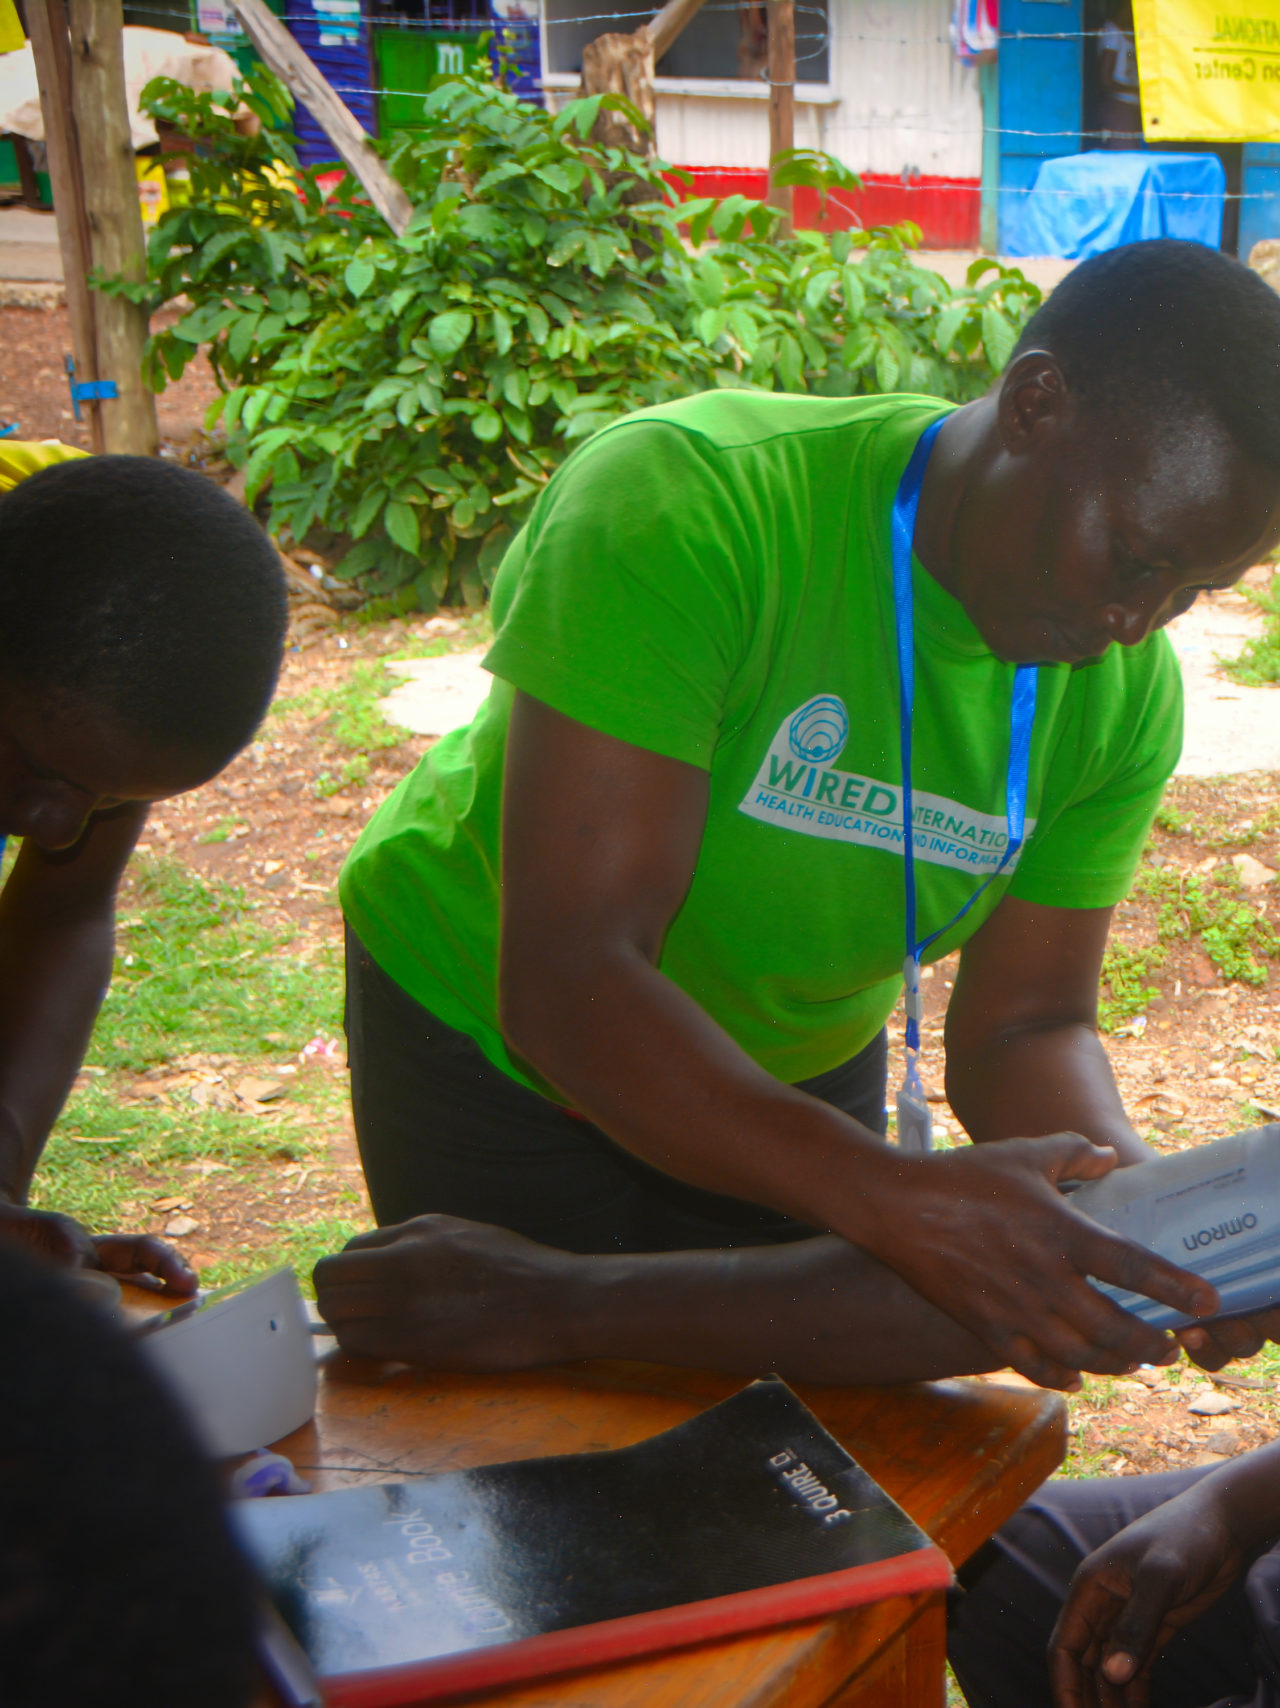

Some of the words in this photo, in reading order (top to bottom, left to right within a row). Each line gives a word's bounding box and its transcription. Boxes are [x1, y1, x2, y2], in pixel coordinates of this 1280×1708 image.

[767, 753, 898, 816] WIRED
[755, 791, 815, 821] HEALTH
[817, 810, 905, 843] EDUCATION
[1182, 1212, 1258, 1251] OMRON
[781, 1462, 838, 1510] QUIRE
[383, 1507, 455, 1564] Book
[825, 1508, 852, 1523] 3
